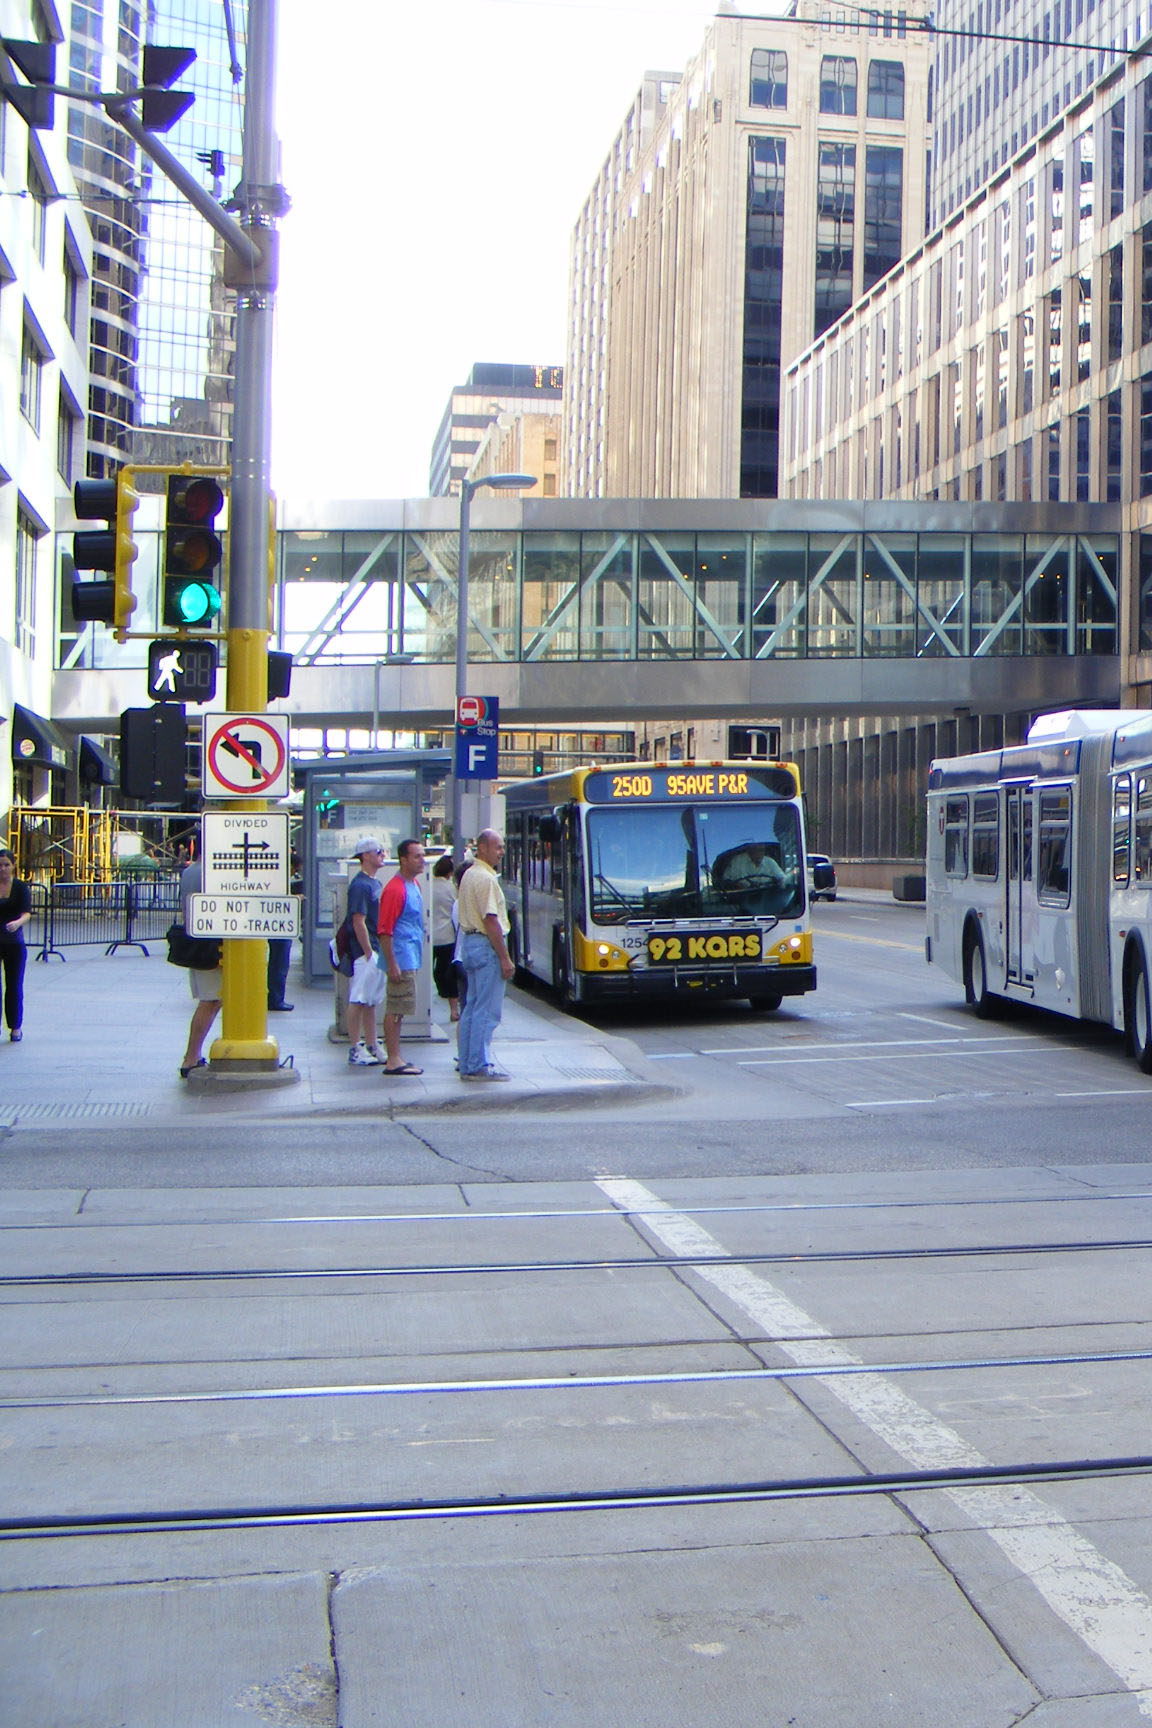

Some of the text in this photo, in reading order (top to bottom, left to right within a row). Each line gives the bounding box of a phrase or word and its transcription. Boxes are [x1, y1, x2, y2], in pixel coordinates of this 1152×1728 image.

[477, 719, 494, 727] Bus
[476, 727, 496, 738] Stop
[468, 744, 487, 771] F
[612, 773, 748, 797] 250D 95AVE P&R
[224, 819, 268, 828] DIVIDED
[220, 882, 271, 891] HIGHWAY
[201, 901, 291, 913] DO NOT TURN
[197, 919, 294, 932] ON TO TRACKS
[649, 934, 761, 960] 92 KQRS
